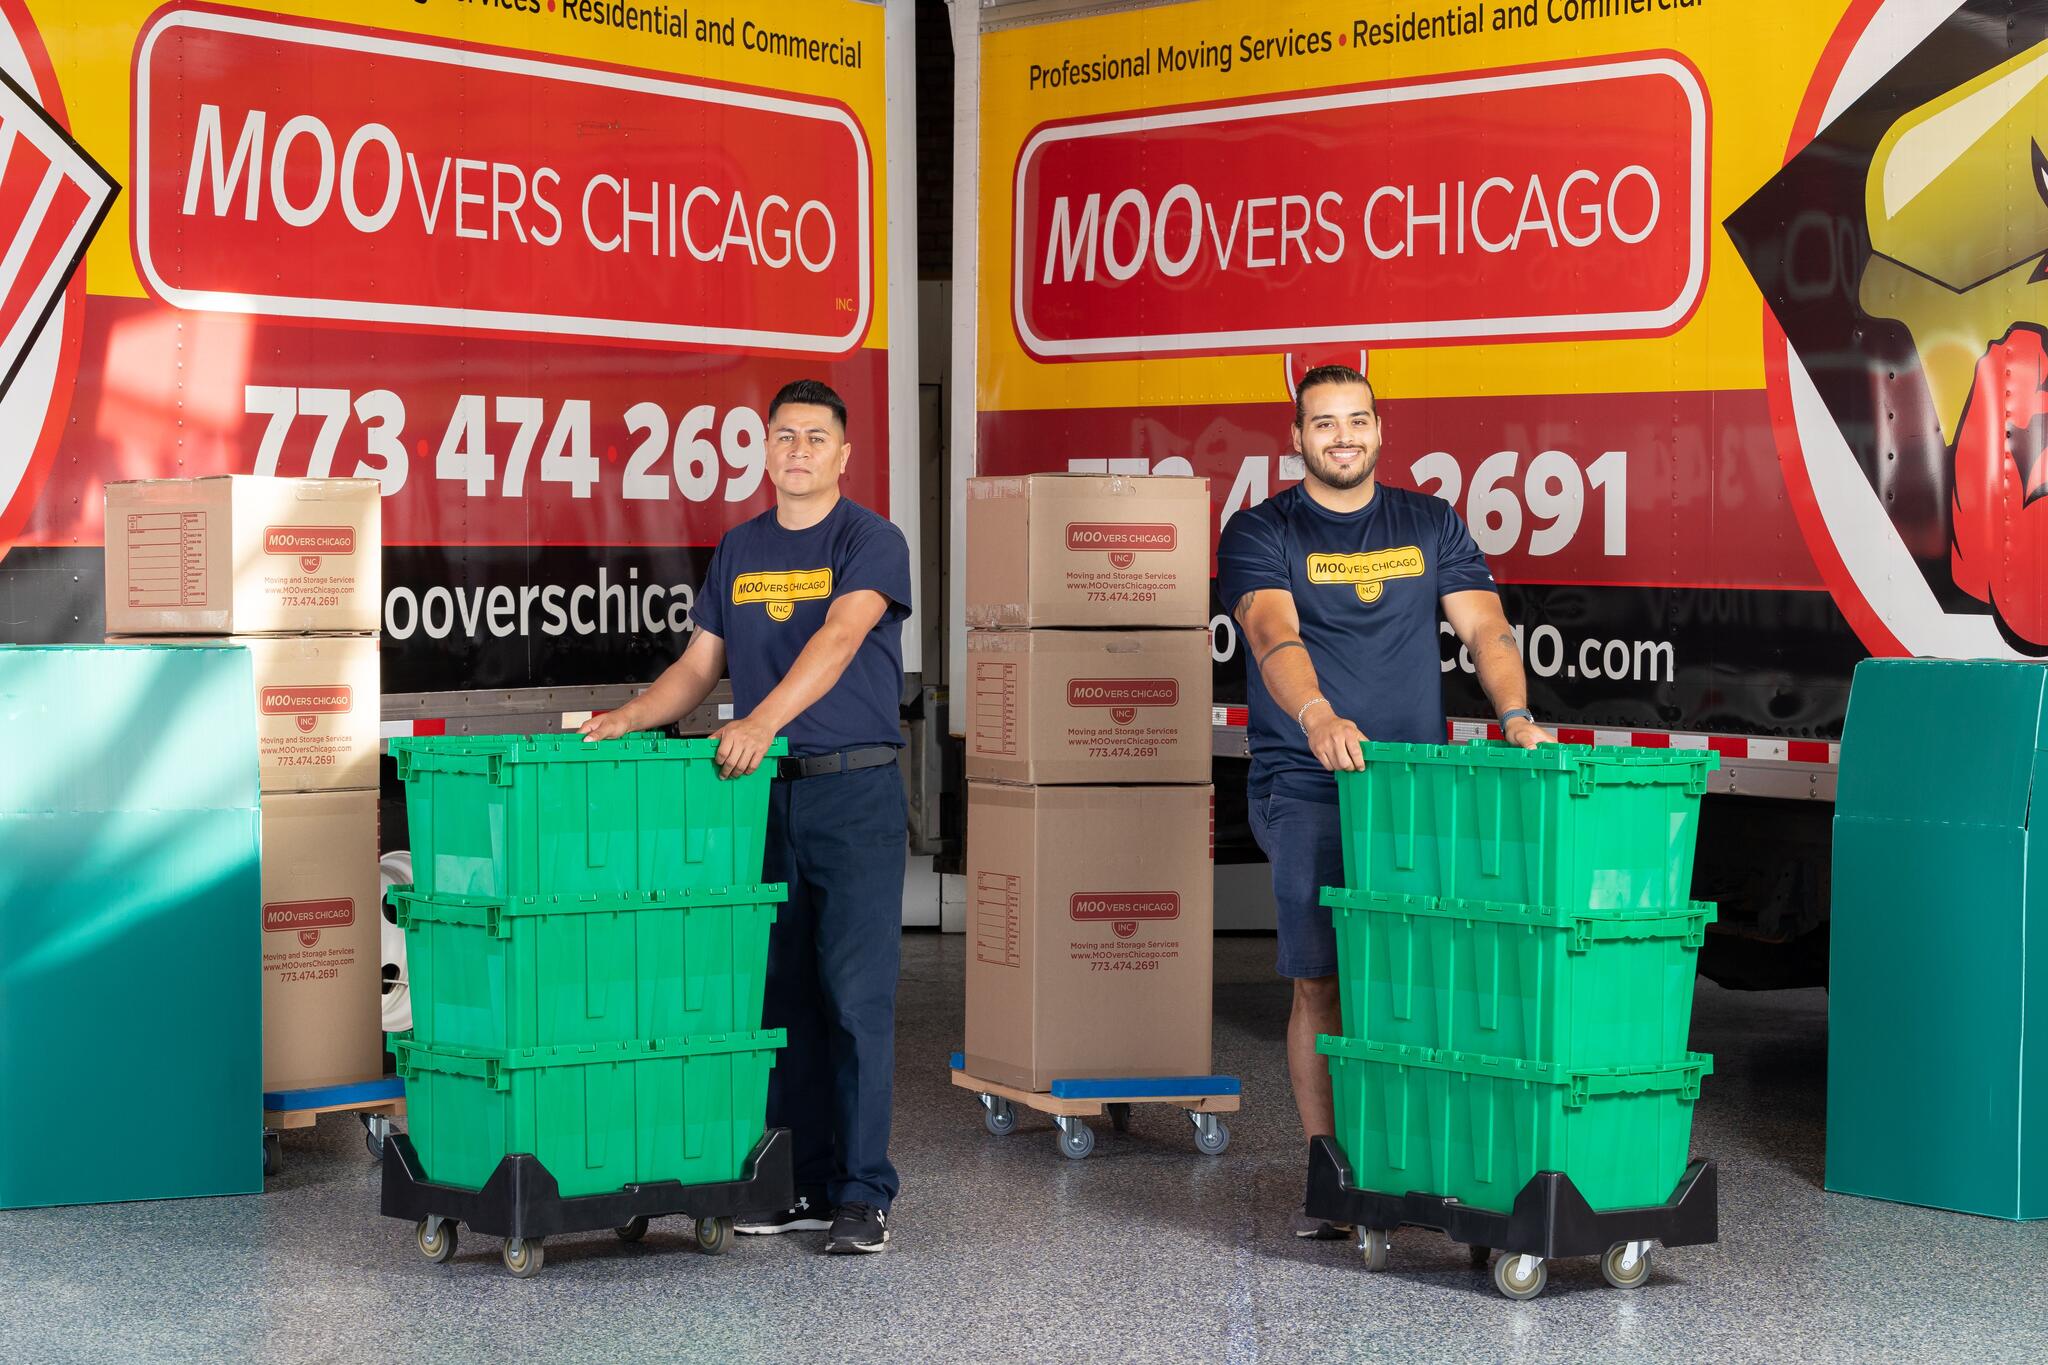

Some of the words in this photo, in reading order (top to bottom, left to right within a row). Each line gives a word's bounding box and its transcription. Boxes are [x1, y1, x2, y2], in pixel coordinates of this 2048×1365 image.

[562, 0, 688, 39] Residential
[695, 17, 735, 47] and
[742, 20, 862, 69] Commercial
[1029, 47, 1151, 90] Professional
[1157, 40, 1233, 73] Moving
[1239, 28, 1333, 63] Services
[1353, 3, 1484, 49] Residential
[1492, 0, 1538, 32] and
[1547, 0, 1702, 24] Comme
[182, 102, 564, 248] MOOVERS
[581, 173, 836, 273] CHICAGO
[1042, 183, 1346, 285] MOOVERS
[1363, 164, 1661, 260] CHICAGO
[835, 297, 856, 312] INC.
[622, 401, 768, 503] 269
[269, 535, 316, 546] MOOVERS
[1072, 532, 1127, 542] MOOVERS
[1371, 557, 1417, 572] CHICAGO
[789, 580, 826, 591] CHICAGO
[282, 597, 338, 606] 773.474.2691
[1088, 592, 1156, 601] 773.474.2691
[384, 566, 694, 640] ooverschica
[1074, 688, 1129, 698] MOOVERS
[266, 695, 312, 706] MOOVERS
[313, 696, 348, 705] CHICAGO
[1089, 748, 1158, 757] 773.474.2691
[278, 756, 336, 766] 773.474.2691
[1077, 901, 1130, 912] MOOVERS
[1133, 903, 1174, 911] CHICAGO
[268, 911, 314, 923] MOOVERS
[315, 910, 350, 920] CHICAGO
[302, 950, 326, 959] Storage
[1091, 961, 1159, 971] 773.474.2691
[281, 968, 338, 982] 773.474.2691
